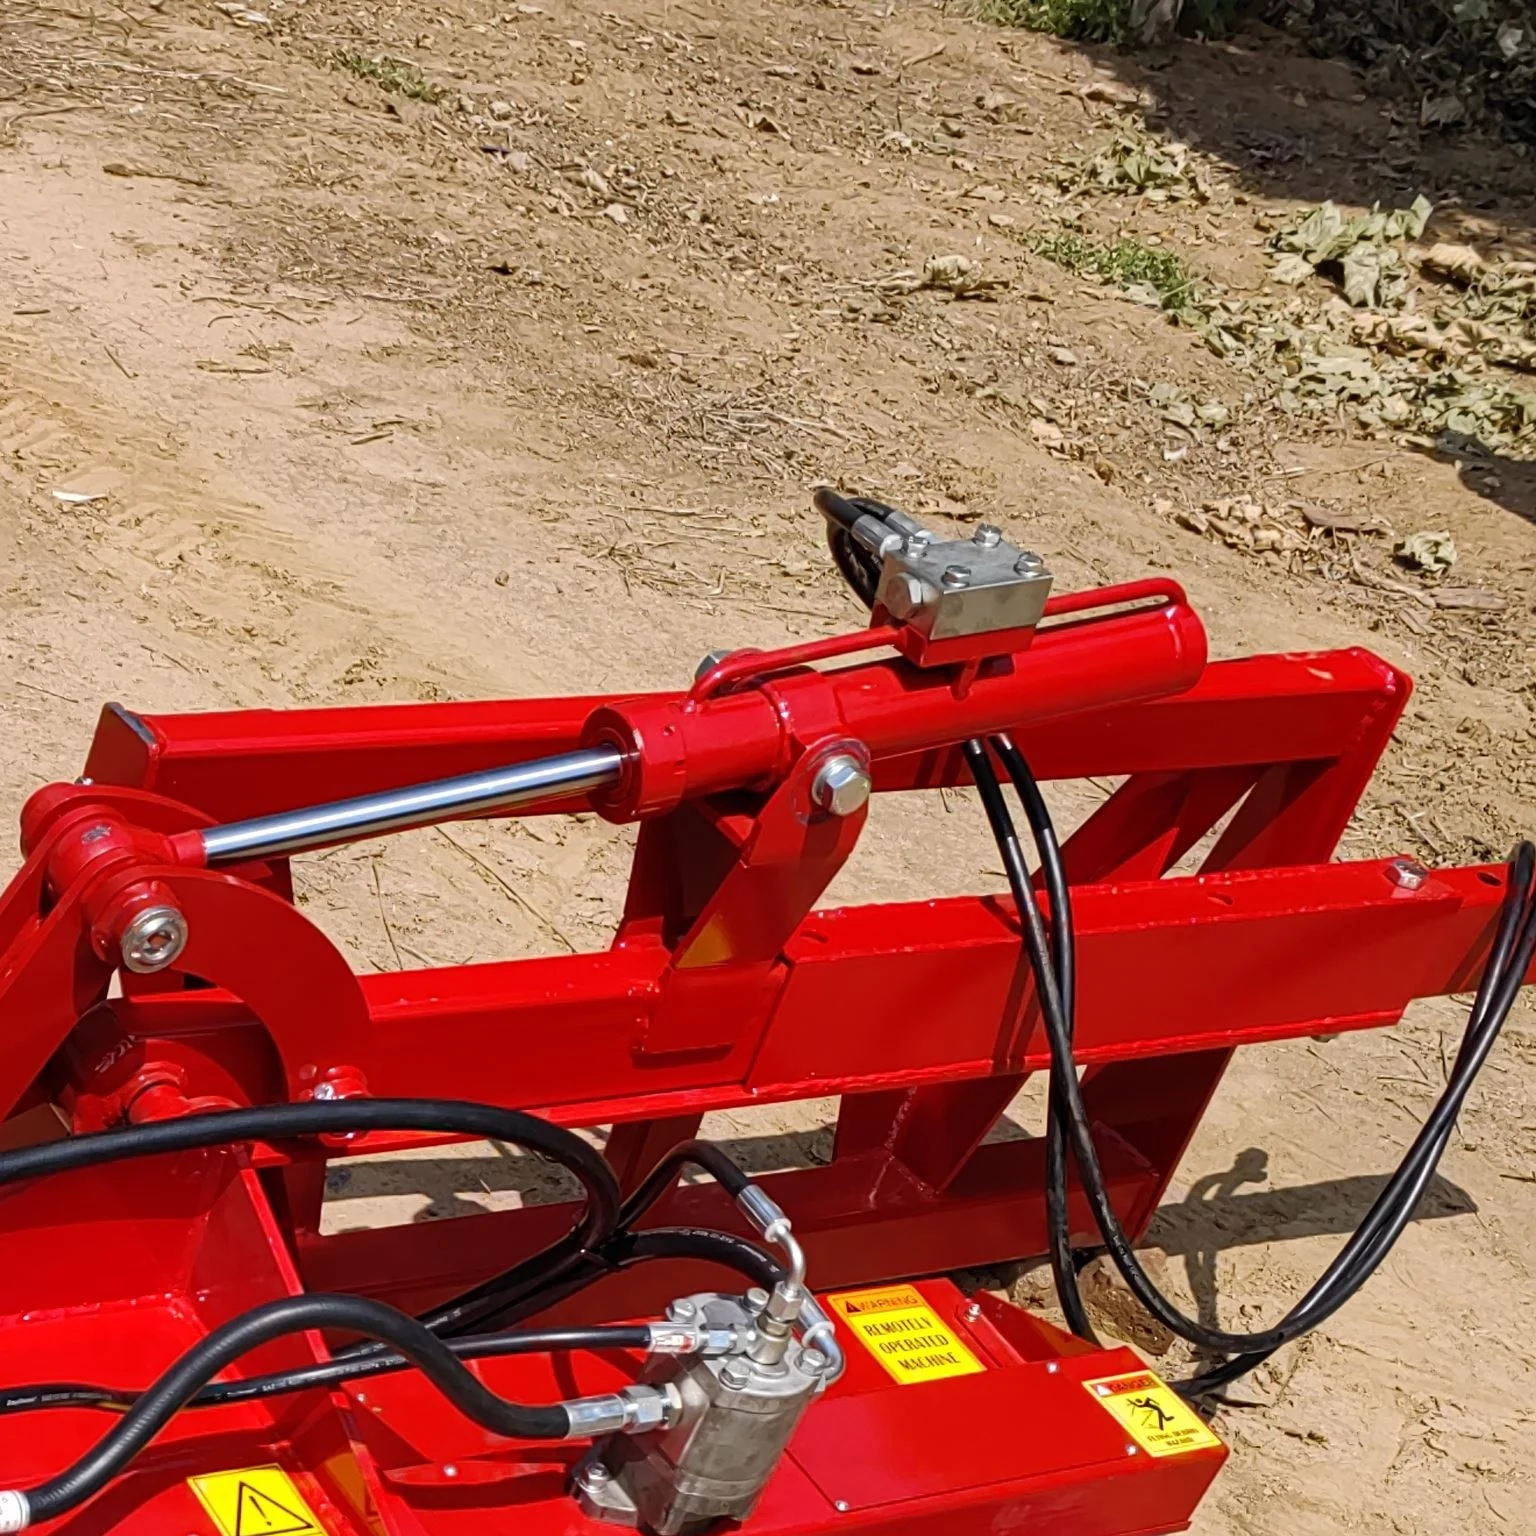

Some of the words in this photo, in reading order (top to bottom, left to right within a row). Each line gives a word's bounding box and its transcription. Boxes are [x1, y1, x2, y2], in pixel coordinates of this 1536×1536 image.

[858, 1295, 918, 1312] WARNING
[863, 1316, 933, 1336] REMOTELY
[879, 1334, 949, 1353] OPERATED
[897, 1352, 960, 1370] MACHINE
